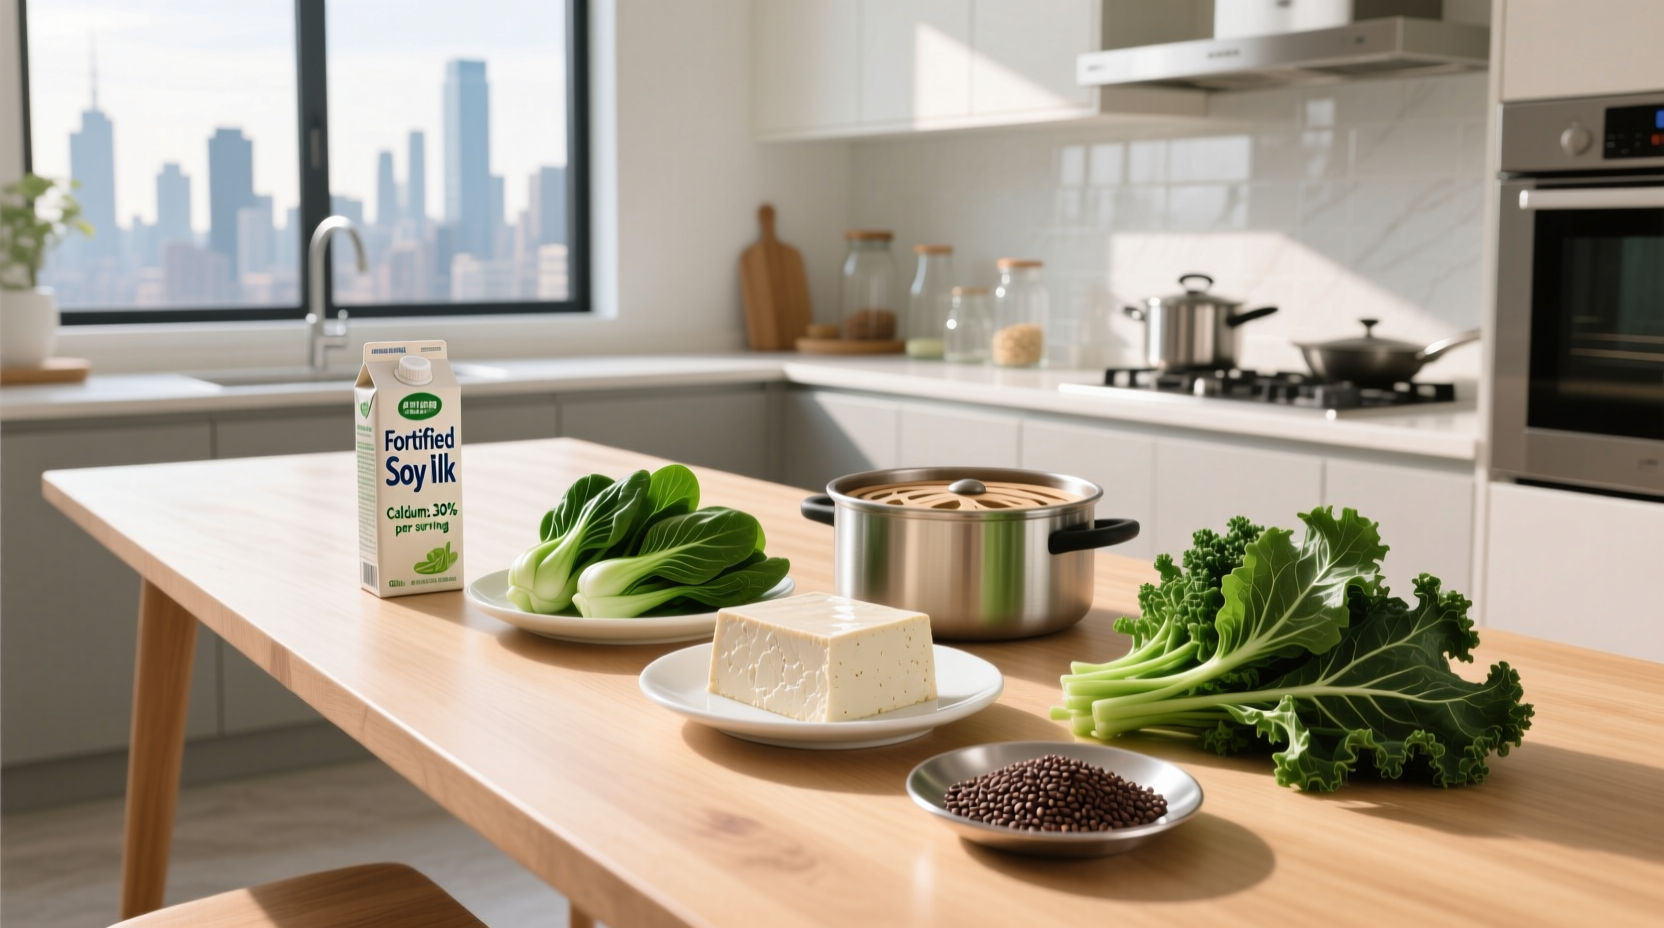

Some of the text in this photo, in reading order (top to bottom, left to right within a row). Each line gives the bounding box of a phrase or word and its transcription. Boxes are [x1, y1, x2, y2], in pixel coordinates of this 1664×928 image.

[385, 426, 454, 451] Fortified
[386, 456, 427, 493] Soy
[432, 501, 458, 517] 30%
